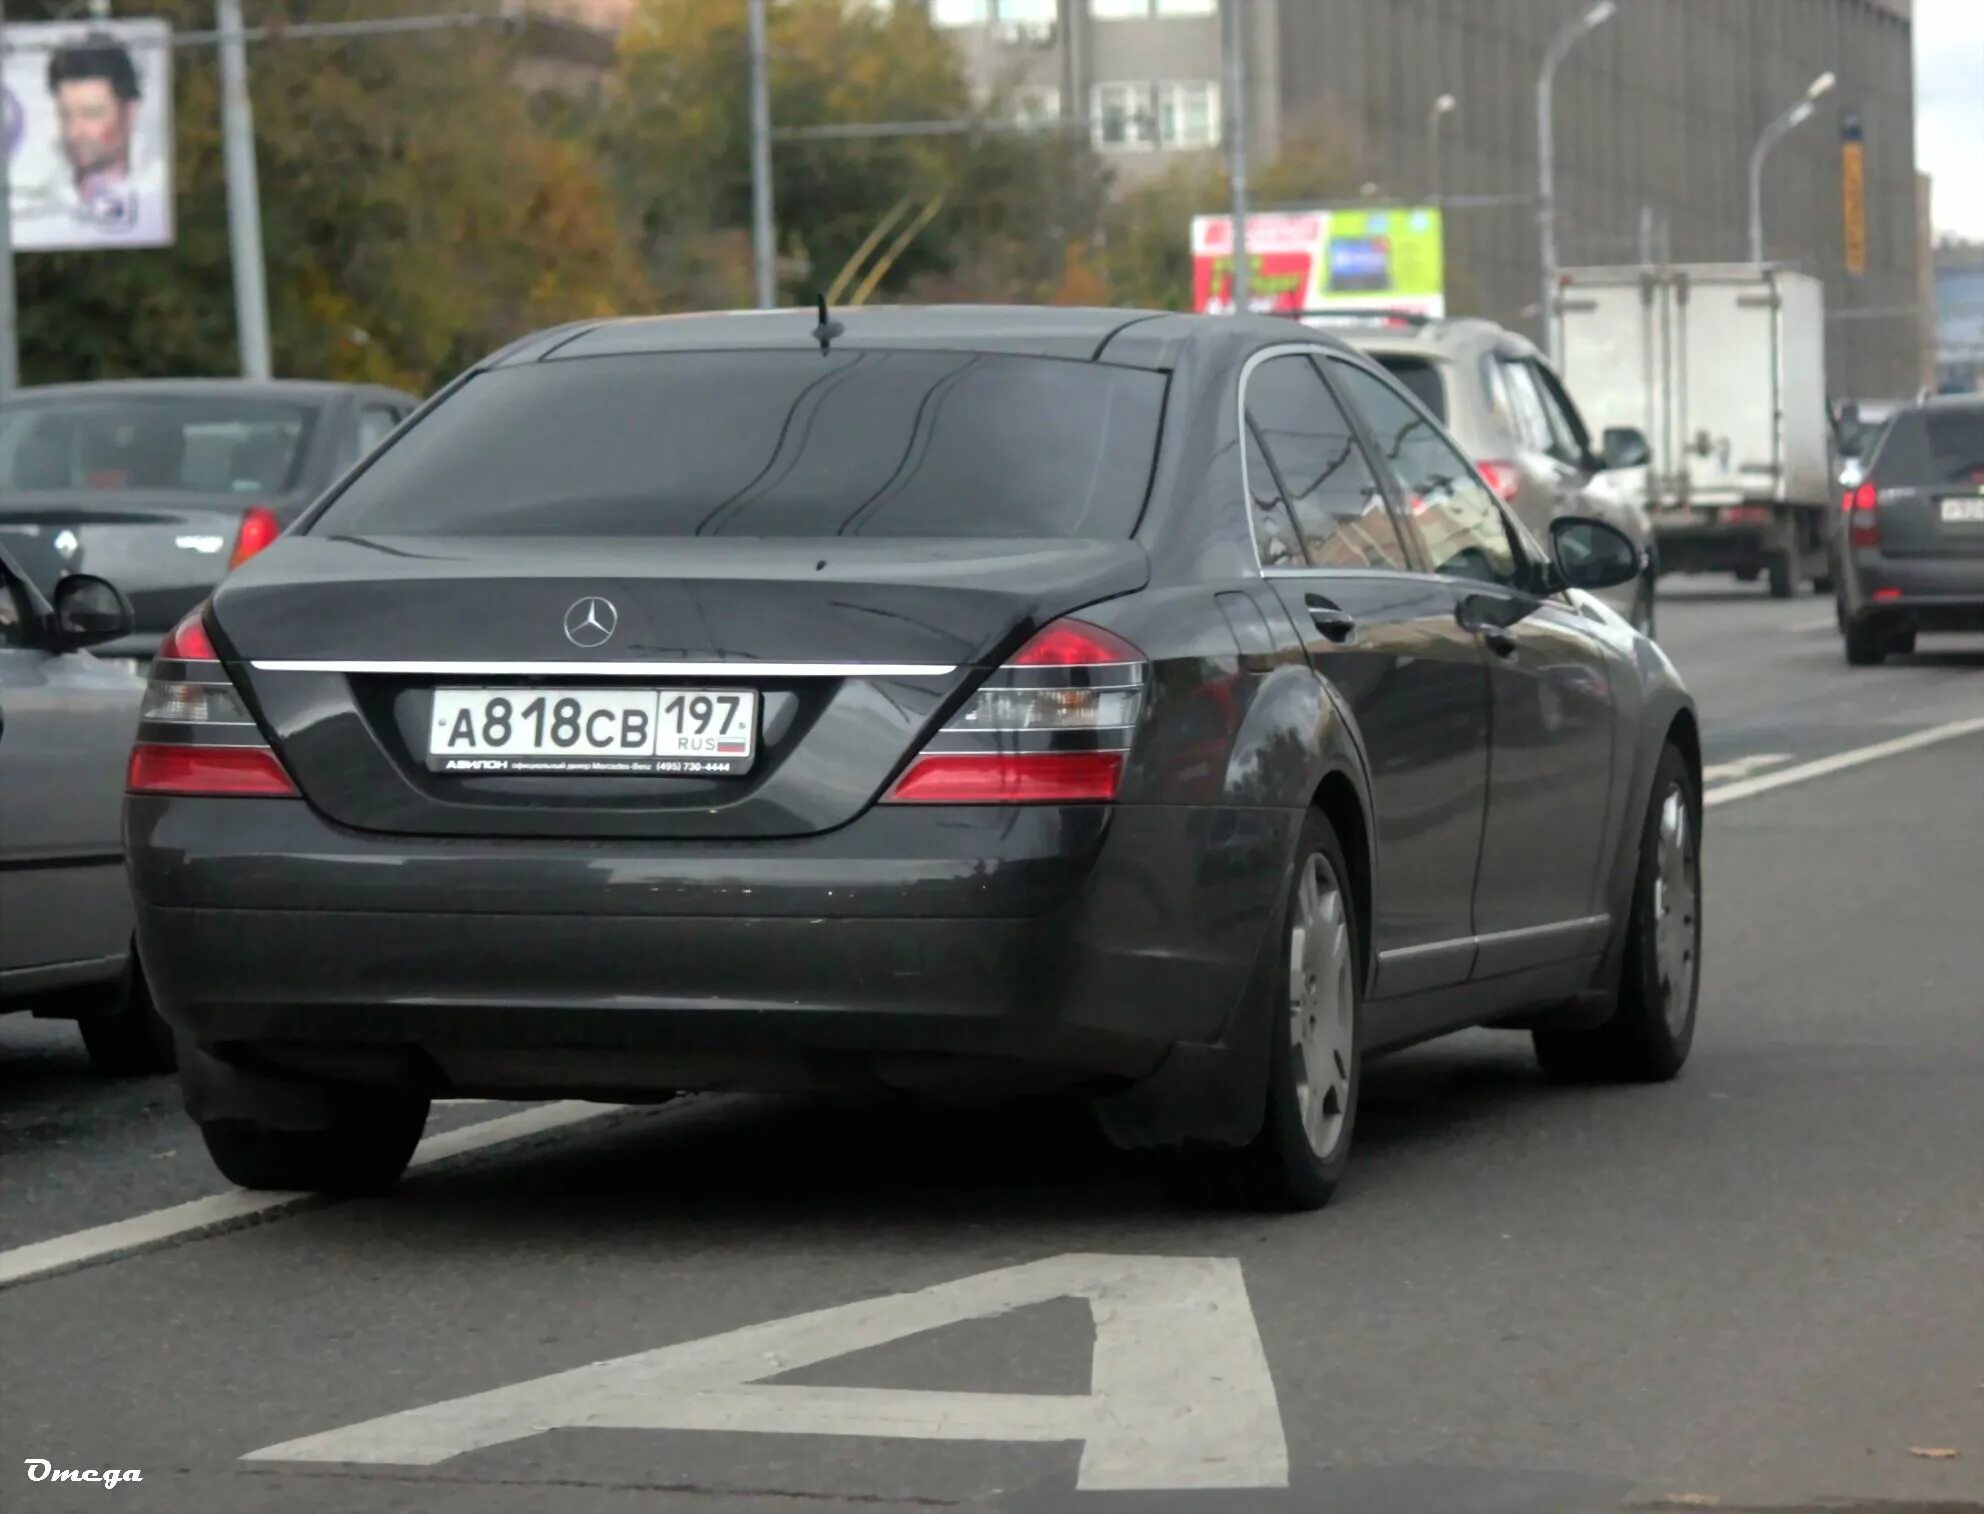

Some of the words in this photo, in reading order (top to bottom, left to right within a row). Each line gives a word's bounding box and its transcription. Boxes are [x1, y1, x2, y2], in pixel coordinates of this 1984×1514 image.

[447, 697, 649, 748] А818СВ
[664, 694, 741, 735] 197
[678, 737, 715, 751] RUS
[446, 760, 508, 770] АВИЛОН
[656, 762, 681, 772] (495)
[683, 762, 730, 772] 730-4444
